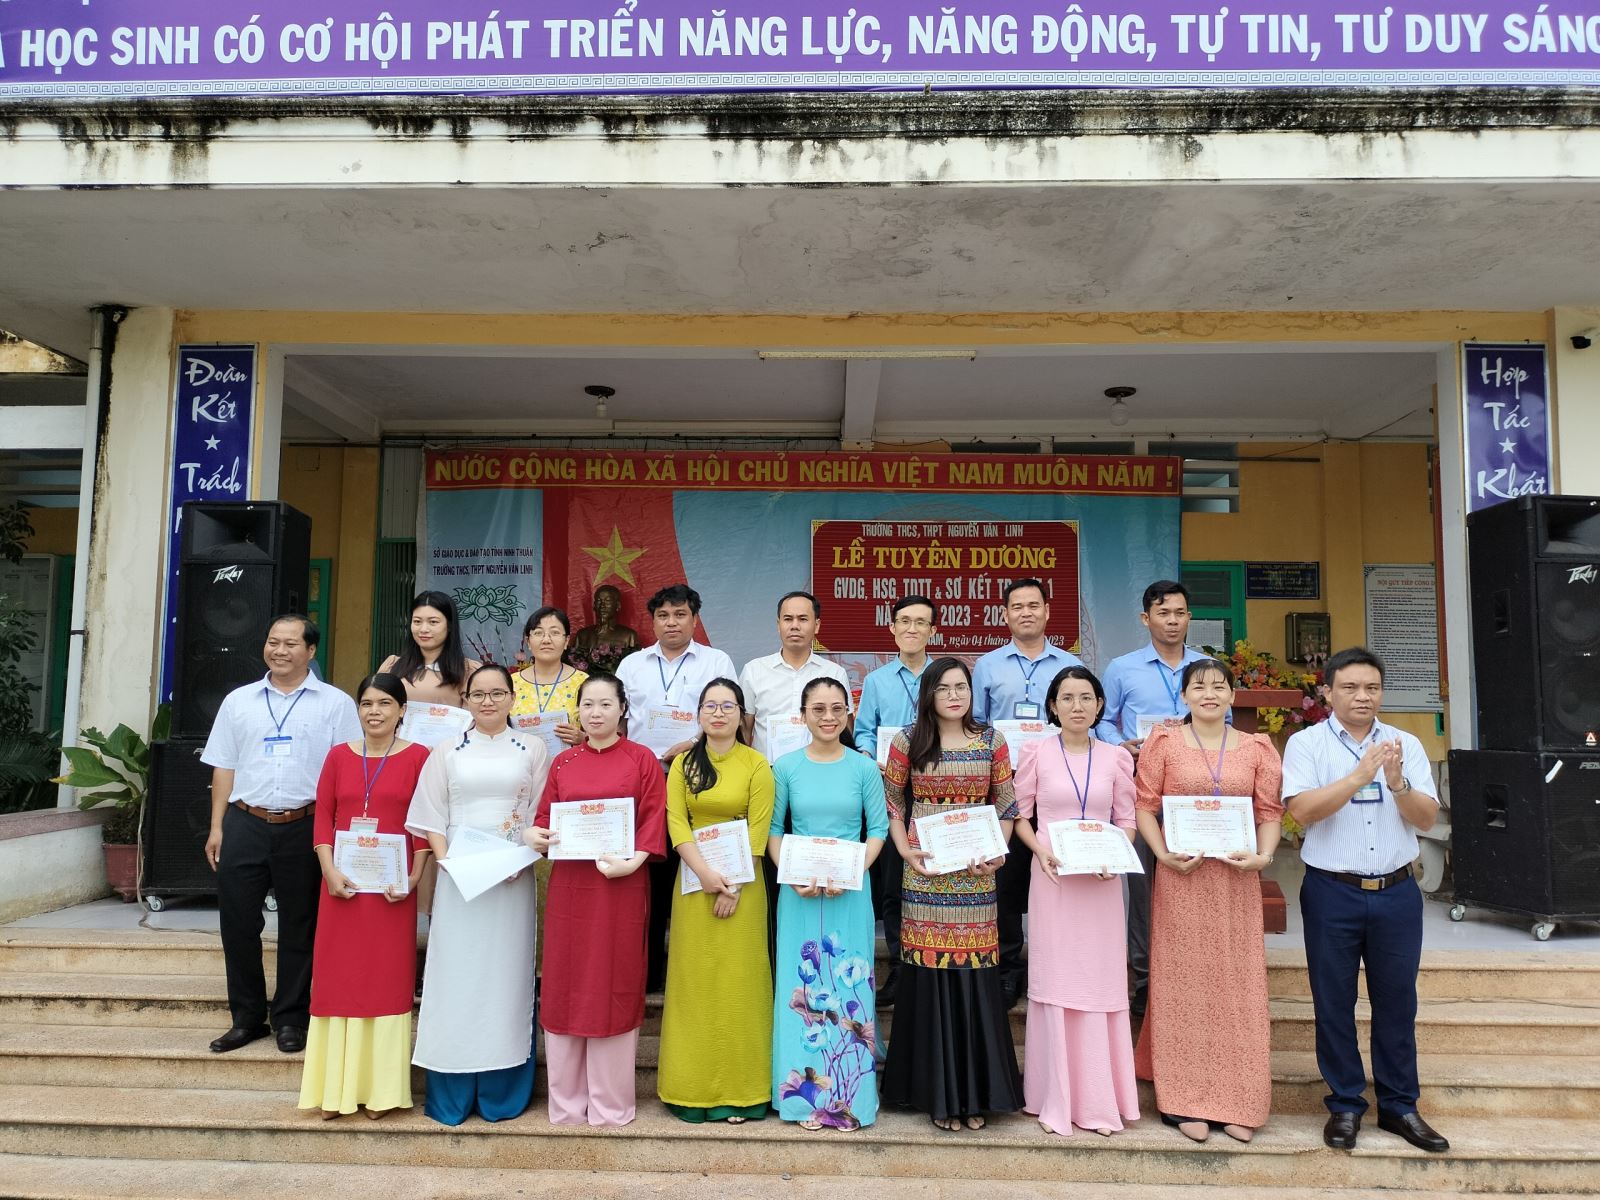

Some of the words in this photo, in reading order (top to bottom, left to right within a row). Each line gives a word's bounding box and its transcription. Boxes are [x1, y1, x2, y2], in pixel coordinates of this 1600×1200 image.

[20, 28, 98, 74] HỌC
[110, 26, 200, 65] SINH
[213, 15, 265, 63] CÓ
[279, 18, 333, 62] CƠ
[345, 12, 411, 68] HỘI
[427, 11, 530, 59] PHÁT
[543, 0, 664, 57] TRIỂN
[679, 9, 787, 56] NĂNG
[802, 9, 892, 63] LỰC,
[908, 8, 1018, 54] NĂNG
[1031, 4, 1157, 61] ĐỘNG,
[1170, 7, 1229, 61] TỰ
[1239, 14, 1321, 61] TIN,
[1334, 7, 1394, 53] TƯ
[1405, 14, 1489, 53] DUY
[185, 358, 247, 386] Đoàn
[1481, 357, 1530, 399] Hợp
[192, 391, 237, 423] Kết
[1483, 402, 1531, 431] Tác
[180, 456, 242, 494] Trách
[435, 454, 500, 481] NƯỚC
[509, 452, 577, 484] CỘNG
[585, 454, 635, 481] HÒA
[644, 454, 677, 481] XÃ
[687, 453, 730, 486] HỘI
[738, 452, 789, 482] CHỦ
[800, 456, 874, 483] NGHĨA
[882, 457, 939, 488] VIỆT
[949, 463, 1004, 485] NAM
[1013, 458, 1088, 486] MUÔN
[1097, 461, 1155, 487] NĂM
[1165, 465, 1173, 487] !
[1477, 462, 1546, 499] Khát
[923, 524, 943, 537] THPT
[948, 521, 979, 537] NGUYỄN
[1005, 524, 1024, 537] LINH
[831, 536, 865, 568] LỄ
[873, 540, 961, 569] TUYÊN
[969, 544, 1057, 569] DƯƠNG
[471, 565, 485, 575] THPT
[520, 565, 533, 575] LINH
[834, 577, 868, 600] GVDG,
[903, 578, 932, 599] TDTT
[935, 586, 942, 600] &
[945, 577, 962, 599] SƠ
[968, 573, 992, 599] KẾT
[875, 600, 896, 626] NĂ
[940, 604, 971, 627] 2023
[972, 634, 983, 646] 04
